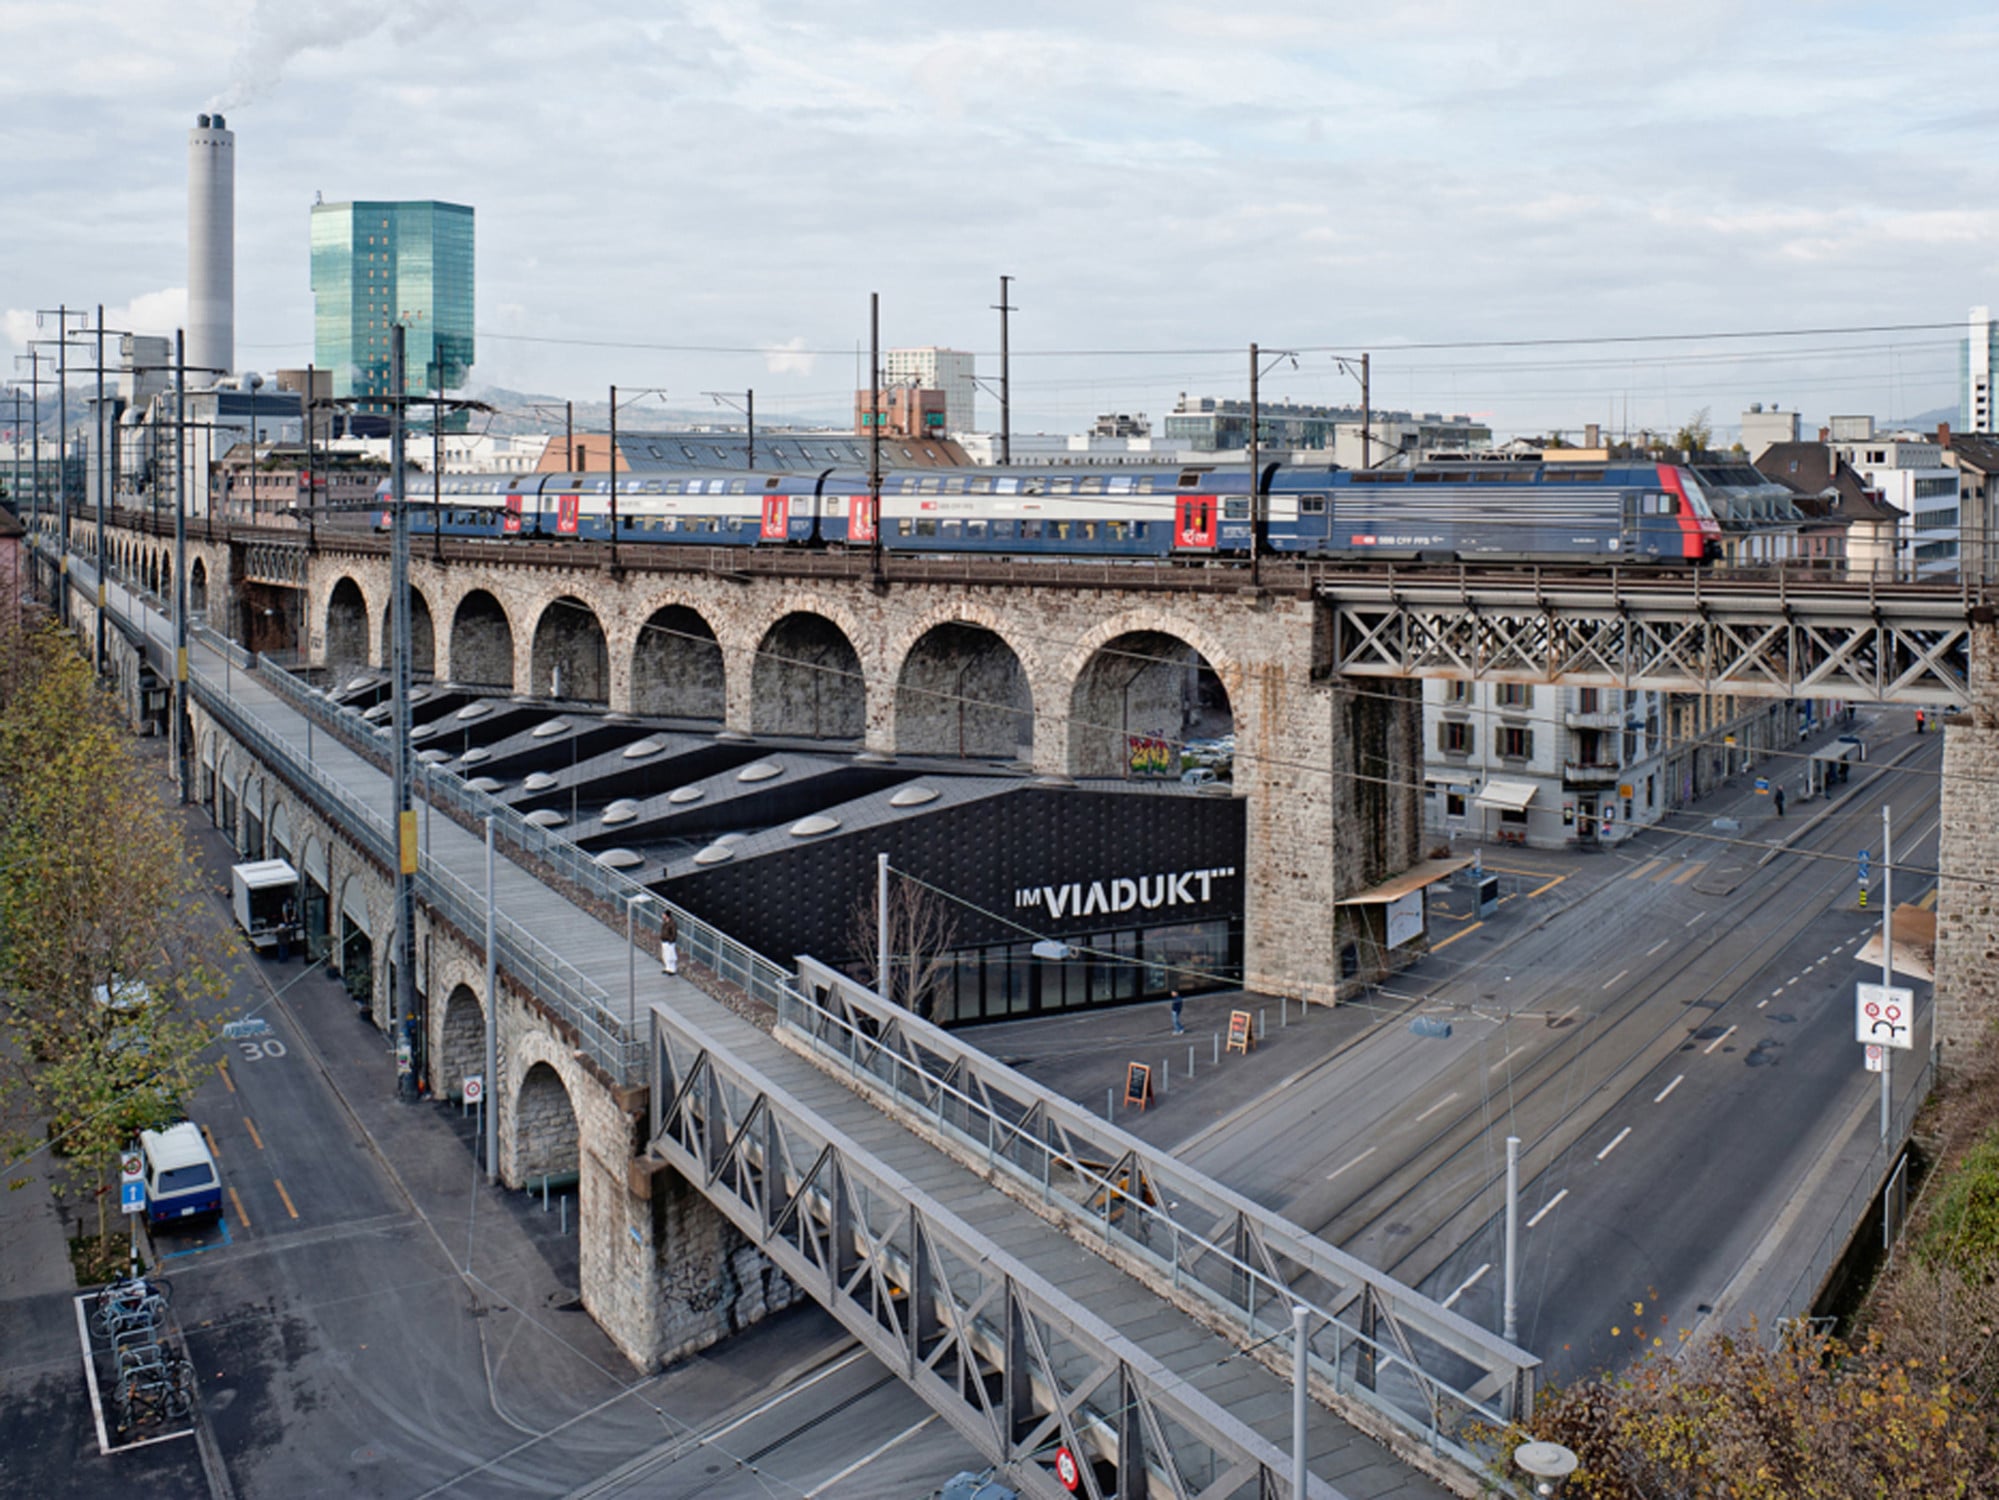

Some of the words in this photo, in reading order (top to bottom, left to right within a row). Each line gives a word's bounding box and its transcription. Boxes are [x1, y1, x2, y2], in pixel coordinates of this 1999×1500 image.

[1015, 887, 1042, 907] IM
[1043, 869, 1213, 919] VIADUKT
[239, 1039, 287, 1061] 30
